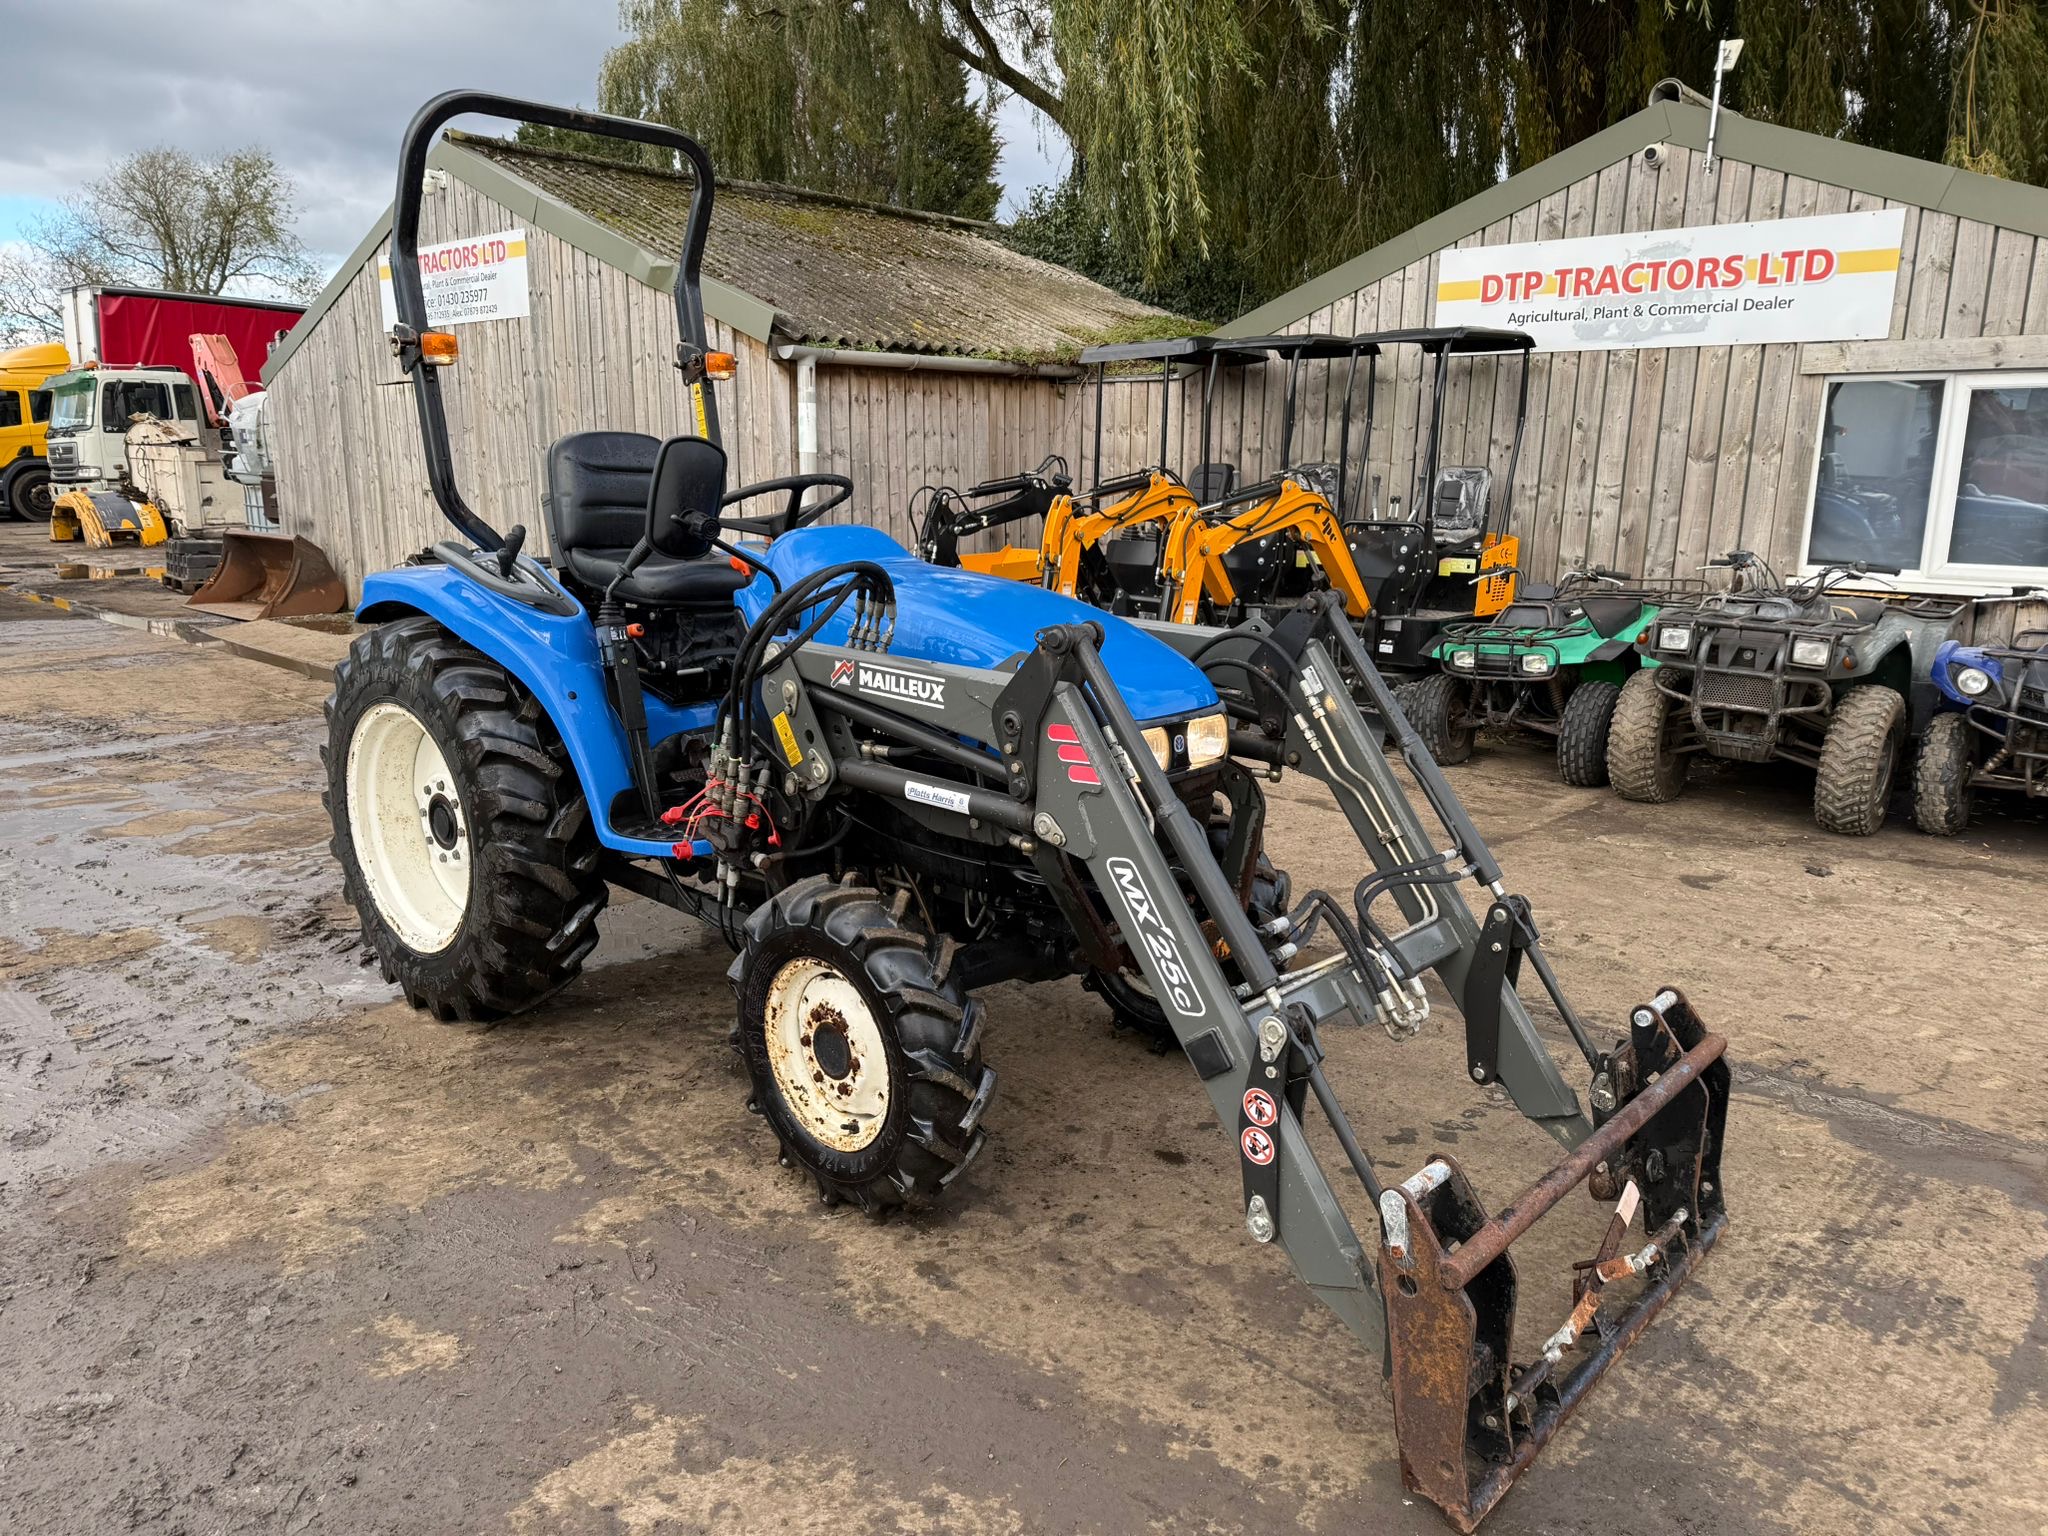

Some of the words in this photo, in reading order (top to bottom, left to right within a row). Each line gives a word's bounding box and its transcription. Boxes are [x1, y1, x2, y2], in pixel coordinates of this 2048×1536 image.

[483, 239, 506, 264] LTD
[450, 273, 479, 286] Commercial
[481, 271, 497, 281] Dealer
[1480, 271, 1544, 303] DTP
[1554, 255, 1744, 297] TRACTORS
[1758, 249, 1835, 284] LTD
[437, 291, 458, 307] 01430
[460, 288, 488, 304] 235977
[1507, 307, 1588, 327] Agricultural,
[1594, 306, 1629, 319] Plant
[1633, 304, 1644, 317] &
[1648, 298, 1739, 316] Commercial
[1743, 295, 1795, 311] Dealer
[858, 667, 946, 703] MAILLEUX
[909, 787, 931, 799] Platts
[931, 792, 955, 805] Harris
[1114, 866, 1161, 928] MX
